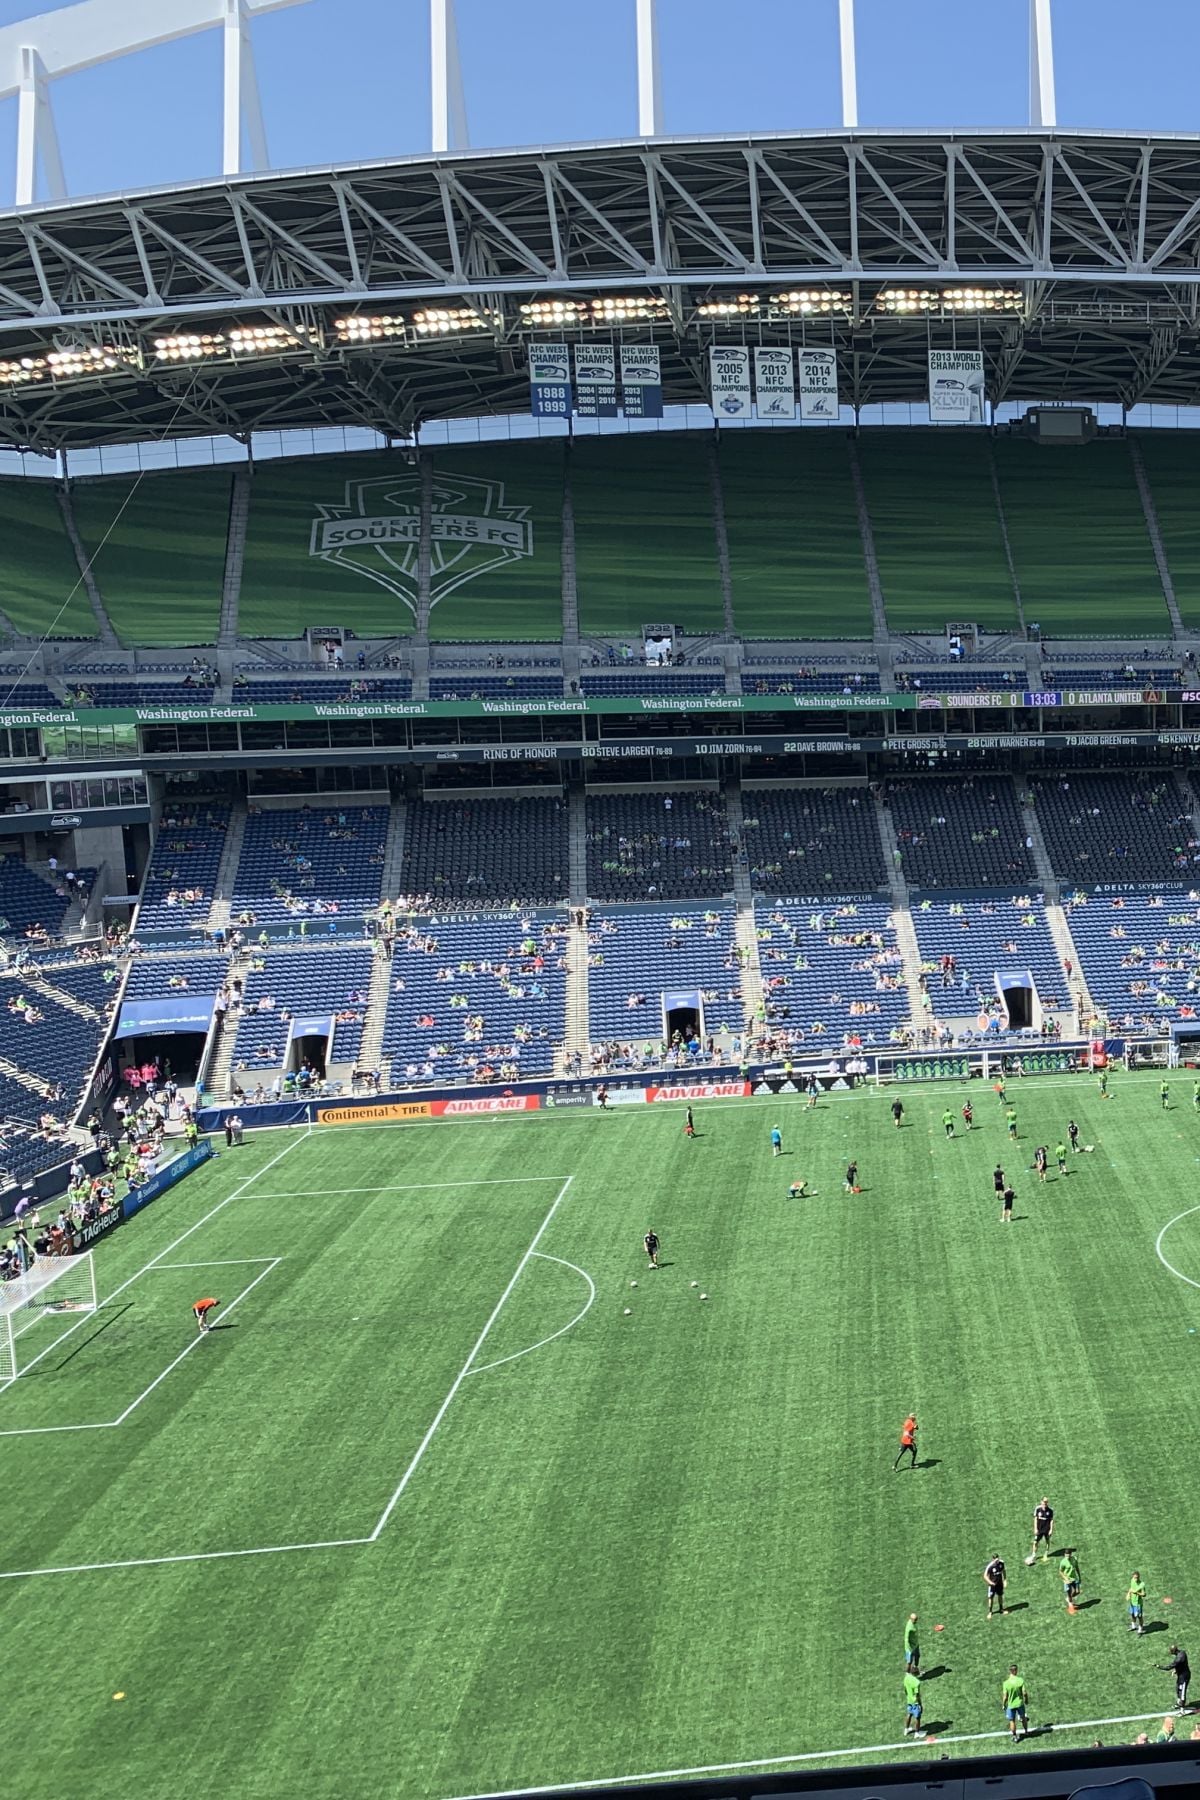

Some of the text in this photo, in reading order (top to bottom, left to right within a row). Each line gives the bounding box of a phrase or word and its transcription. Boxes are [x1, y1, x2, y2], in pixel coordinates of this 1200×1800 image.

[546, 345, 566, 353] WEST
[530, 354, 568, 363] CHAMPS
[576, 355, 613, 364] CHAMPS
[622, 356, 658, 364] CHAMPS
[931, 352, 981, 362] 2013 WORLD
[717, 363, 743, 374] 2005
[762, 365, 787, 375] 2013
[805, 366, 831, 376] 2014
[931, 362, 981, 370] CHAMPIONS
[721, 375, 740, 383] NFC
[766, 376, 784, 385] NFC
[810, 377, 827, 385] NFC
[537, 388, 565, 398] 1988
[932, 396, 969, 406] XLVIII
[538, 401, 566, 412] 1999
[487, 529, 519, 544] FC
[794, 696, 892, 708] Washington Federal.
[947, 694, 1016, 706] SOUNDERS FC 0
[1030, 694, 1056, 705] 13:03
[1069, 692, 1141, 705] 0 ATLANTA UNITED
[482, 700, 590, 713] Washington Federal.
[642, 698, 744, 710] Washington Federal.
[136, 707, 257, 721] Washington Federal.
[315, 704, 428, 716] Washington Federal.
[32, 712, 78, 722] Federal.
[968, 738, 1028, 748] 28 CURT WARNER
[1065, 736, 1121, 745] 79 JACOB GREEN
[1158, 734, 1169, 743] 45
[1170, 734, 1191, 743] KENNY
[696, 744, 744, 754] 10 JIM ZORN
[784, 742, 844, 752] 22 DAVE BROWN
[889, 740, 930, 749] PETE GROSS
[484, 748, 557, 759] RING OF HONOR
[582, 746, 655, 756] 80 STEVE LARGENT
[786, 897, 820, 905] DELTA
[441, 914, 478, 923] DELTA
[656, 1085, 743, 1099] ADVOCARE
[556, 1096, 587, 1105] amperity
[449, 1100, 524, 1114] ADVOCARE
[322, 1106, 427, 1122] Continental TIRE
